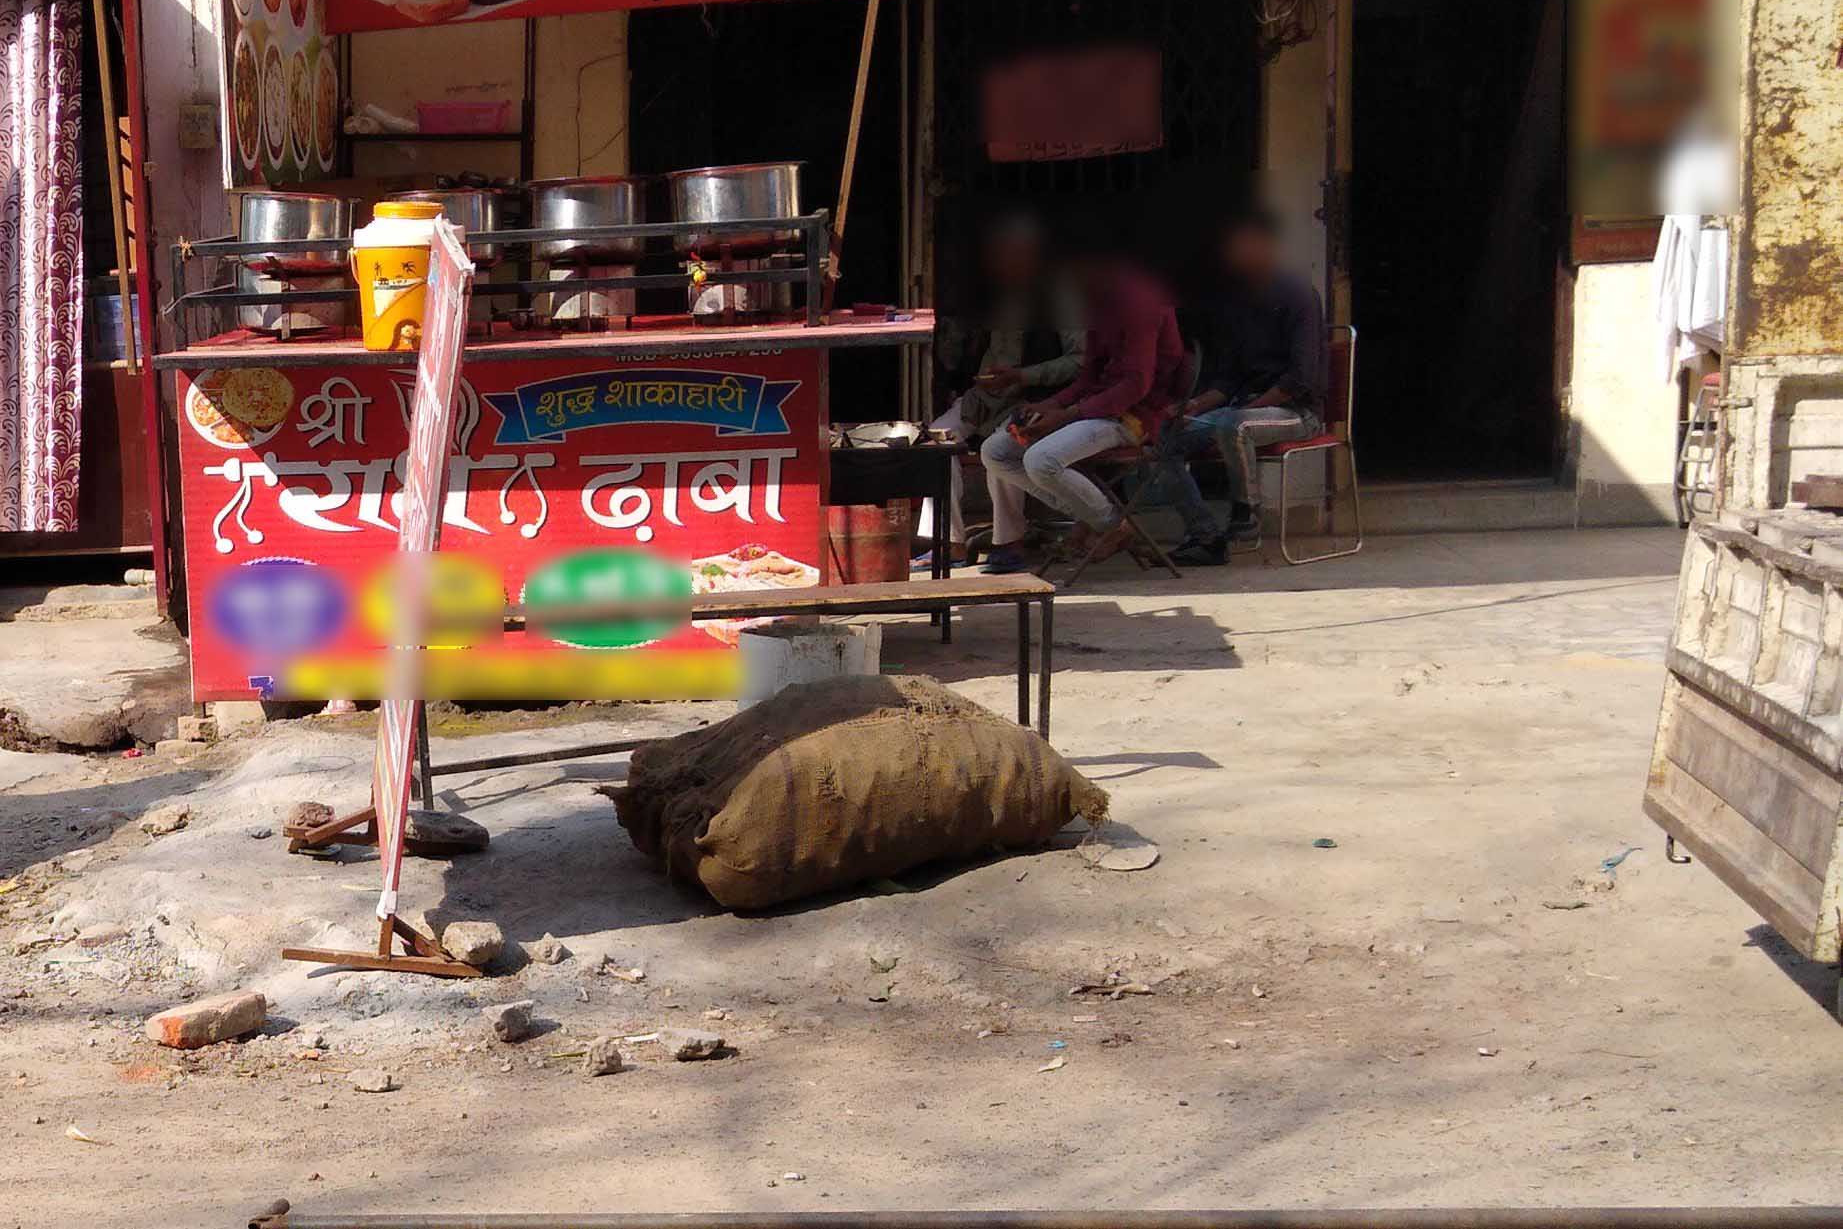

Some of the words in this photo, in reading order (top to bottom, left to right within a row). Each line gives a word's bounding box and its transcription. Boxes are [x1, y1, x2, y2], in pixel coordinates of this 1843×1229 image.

[295, 376, 373, 447] श्री
[536, 384, 596, 427] शुद्ध
[603, 371, 748, 413] शाकाहारी
